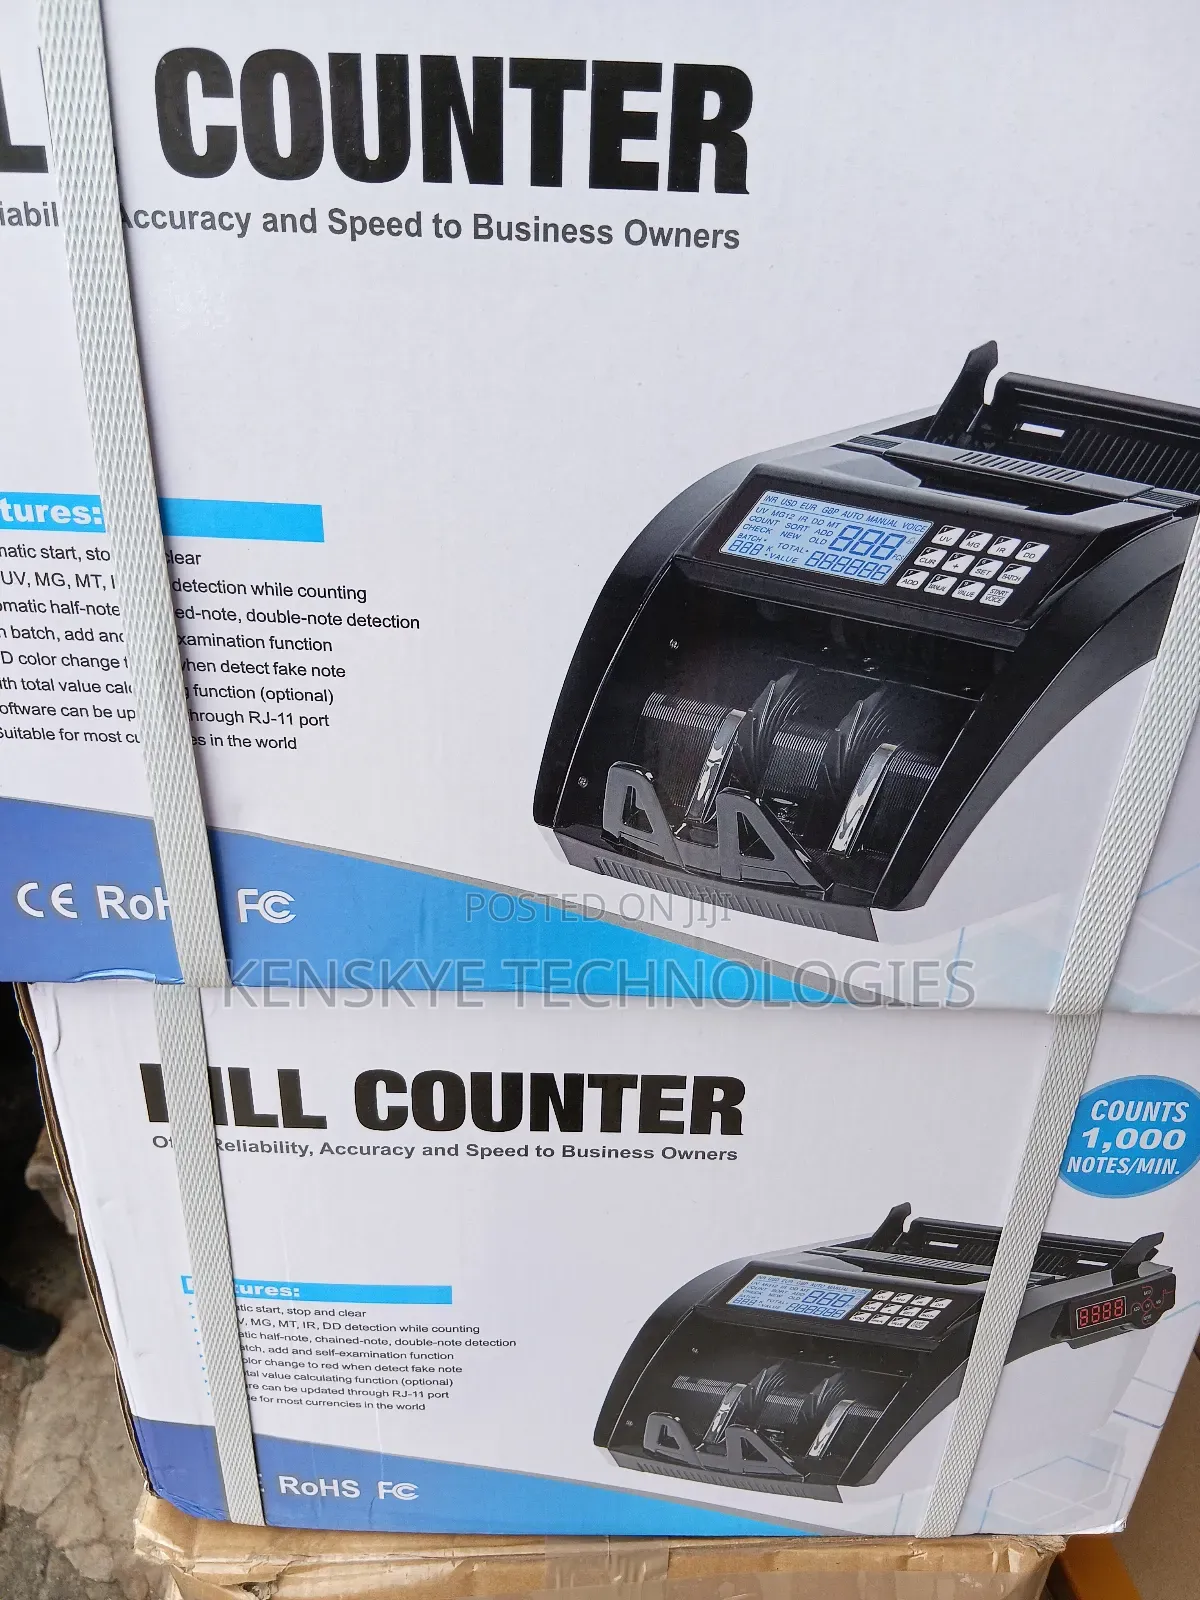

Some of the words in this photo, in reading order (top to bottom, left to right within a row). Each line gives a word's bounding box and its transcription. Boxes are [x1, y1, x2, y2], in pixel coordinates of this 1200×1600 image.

[154, 47, 754, 194] COUNTER
[120, 203, 251, 238] Accuracy
[262, 208, 317, 233] and
[327, 207, 423, 241] Speed
[432, 214, 462, 238] to
[473, 213, 613, 245] Business
[624, 219, 740, 249] Owners
[781, 498, 797, 507] USD
[800, 502, 817, 511] EUR
[821, 506, 840, 515] GBP
[841, 510, 864, 520] AUTO
[866, 515, 898, 527] MANUAL
[902, 521, 928, 532] VOICE
[742, 523, 773, 534] CHECK
[780, 531, 802, 540] NEW
[808, 536, 828, 545] OLD
[749, 515, 780, 526] COUNT
[785, 522, 810, 532] SORT
[814, 529, 834, 537] ADD
[40, 546, 82, 562] start,
[86, 547, 111, 561] sto
[0, 571, 31, 588] UV,
[34, 572, 71, 590] MG,
[75, 574, 107, 591] MT,
[172, 578, 247, 596] detection
[251, 583, 293, 597] while
[297, 585, 367, 603] counting
[0, 599, 47, 613] matic
[174, 606, 242, 623] ed-note,
[246, 608, 343, 626] double-note
[347, 613, 420, 629] detection
[10, 625, 61, 642] batch,
[65, 628, 95, 642] add
[178, 633, 265, 649] xamination
[269, 636, 333, 652] function
[18, 652, 57, 666] color
[61, 654, 120, 671] change
[220, 660, 270, 675] detect
[273, 662, 307, 676] fake
[311, 664, 346, 678] note
[21, 678, 55, 691] total
[59, 679, 102, 694] value
[193, 684, 255, 699] function
[260, 686, 334, 705] (optional)
[61, 707, 89, 718] can
[93, 705, 113, 718] be
[188, 709, 245, 726] hrough
[249, 711, 293, 726] RJ-11
[300, 713, 330, 728] port
[59, 728, 80, 741] for
[83, 730, 122, 743] most
[210, 734, 223, 747] in
[227, 735, 252, 748] the
[255, 736, 297, 750] world
[354, 1069, 746, 1136] COUNTER
[1090, 1099, 1190, 1123] COUNTS
[1082, 1127, 1187, 1154] 1,000
[319, 1142, 416, 1159] Accuracy
[422, 1143, 459, 1157] and
[466, 1143, 529, 1159] Speed
[535, 1145, 555, 1158] to
[562, 1145, 654, 1159] Business
[661, 1146, 738, 1161] Owners
[1066, 1156, 1180, 1175] NOTES/MIN.
[287, 1308, 311, 1317] stop
[314, 1308, 335, 1317] and
[338, 1309, 366, 1318] clear
[344, 1323, 397, 1332] detection
[400, 1325, 429, 1333] while
[431, 1325, 480, 1335] counting
[395, 1338, 462, 1347] double-note
[464, 1338, 517, 1347] detection
[268, 1346, 289, 1354] add
[292, 1348, 313, 1356] and
[315, 1349, 407, 1359] self-examination
[410, 1351, 454, 1360] function
[242, 1357, 262, 1365] olor
[265, 1358, 305, 1369] change
[308, 1361, 318, 1369] to
[321, 1362, 339, 1370] red
[342, 1363, 372, 1371] when
[374, 1364, 409, 1373] detect
[411, 1365, 435, 1373] fake
[438, 1365, 463, 1373] note
[262, 1372, 291, 1380] value
[294, 1374, 352, 1384] calculating
[355, 1375, 398, 1384] function
[401, 1377, 453, 1387] (optional)
[284, 1385, 298, 1393] be
[300, 1387, 345, 1397] updated
[348, 1388, 389, 1398] through
[392, 1390, 424, 1398] RJ-11
[427, 1390, 450, 1399] port
[260, 1395, 274, 1403] for
[277, 1397, 303, 1405] most
[305, 1399, 361, 1408] currencies
[364, 1401, 374, 1409] in
[376, 1401, 394, 1410] the
[396, 1402, 426, 1411] world
[278, 1475, 361, 1499] RoHS
